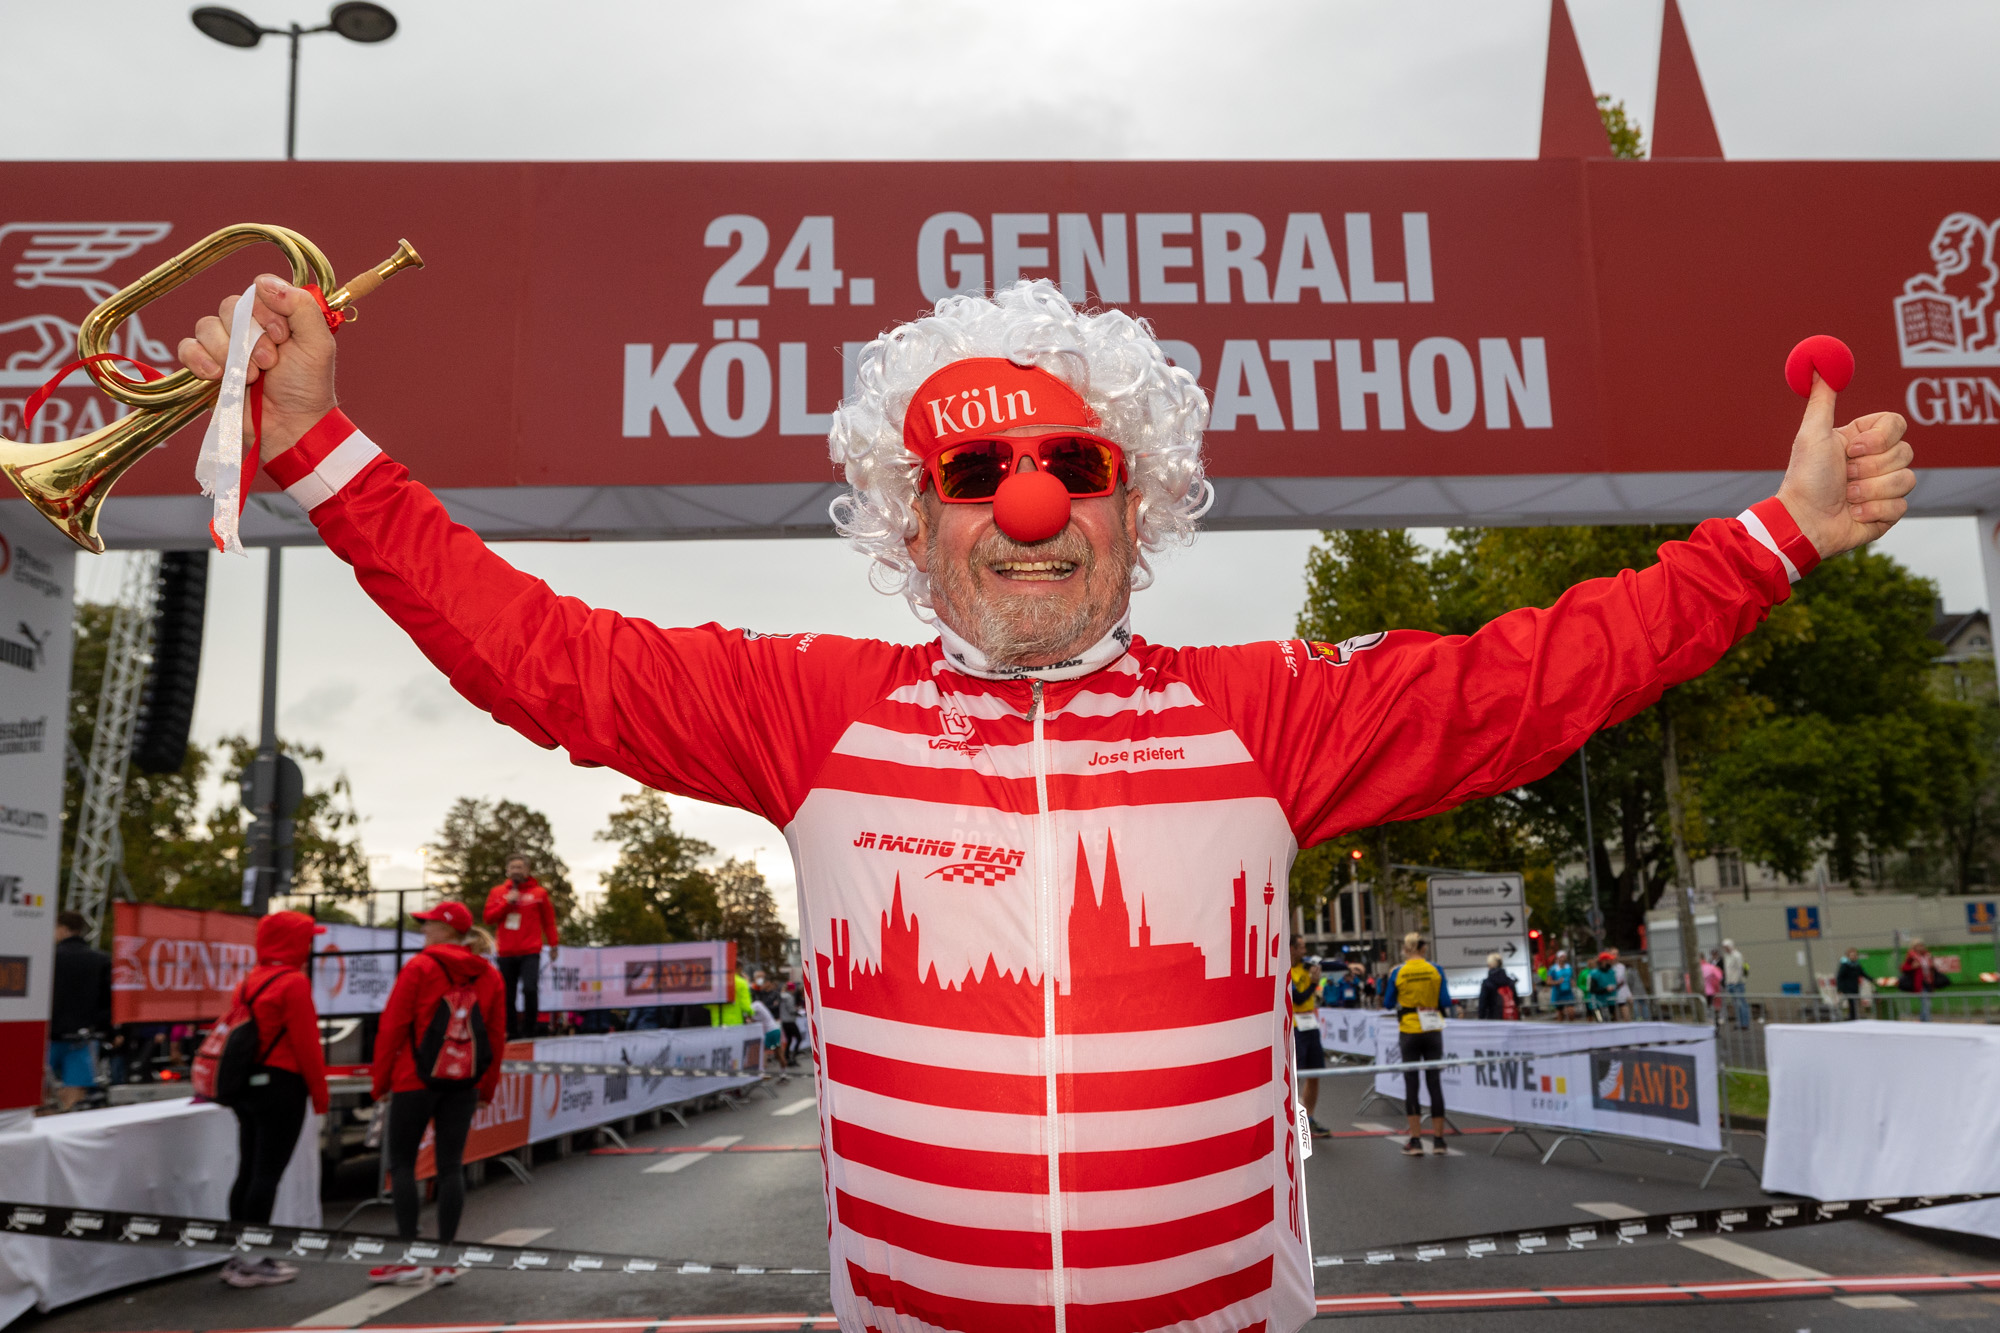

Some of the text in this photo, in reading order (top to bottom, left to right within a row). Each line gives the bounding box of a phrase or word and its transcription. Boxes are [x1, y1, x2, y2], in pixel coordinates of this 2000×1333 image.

[703, 211, 1435, 306] 24. GENERALI
[622, 318, 868, 438] KÖL
[927, 385, 1037, 439] Köln
[928, 739, 972, 751] VERG
[1088, 747, 1185, 766] Jose Riefert
[853, 831, 877, 849] JR
[878, 834, 956, 858] RACING
[961, 843, 1026, 867] TEAM
[1474, 1048, 1538, 1093] REWE
[1629, 1060, 1690, 1111] AWB
[1532, 1097, 1569, 1112] GROUP
